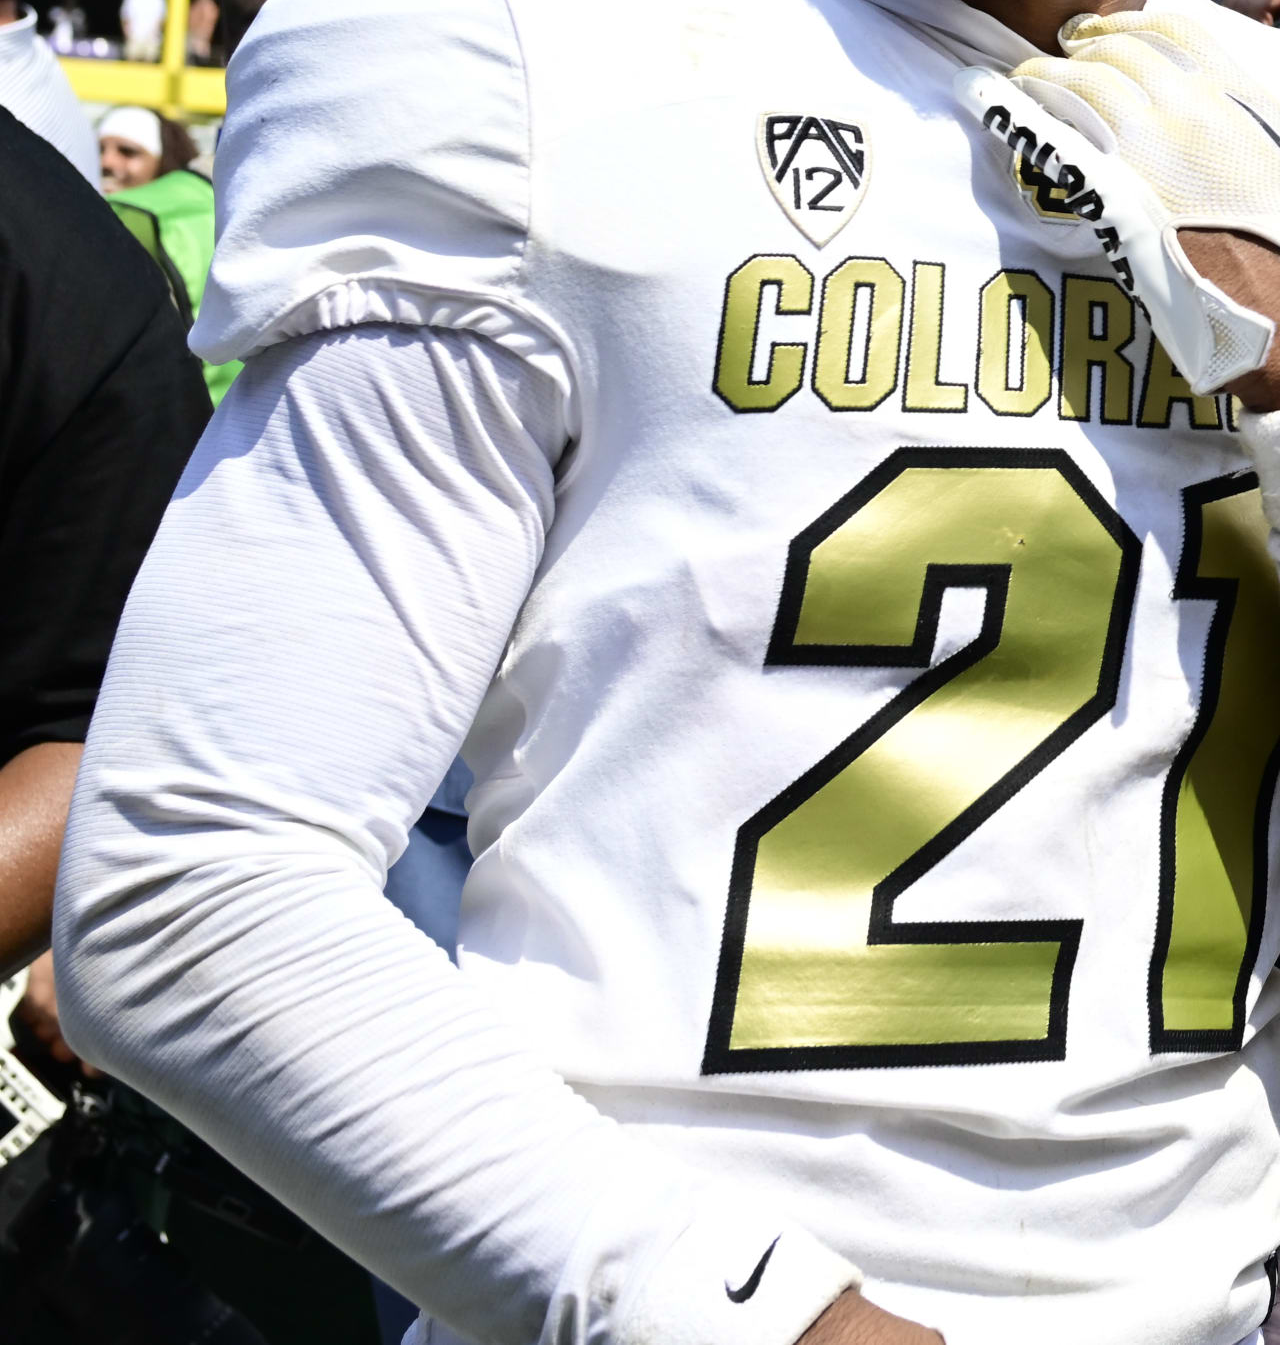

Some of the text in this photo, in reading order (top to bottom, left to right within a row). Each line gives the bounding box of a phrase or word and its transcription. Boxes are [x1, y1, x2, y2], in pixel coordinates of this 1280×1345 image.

[765, 115, 865, 190] PAC
[792, 166, 845, 212] 12
[712, 253, 1243, 433] COLORA
